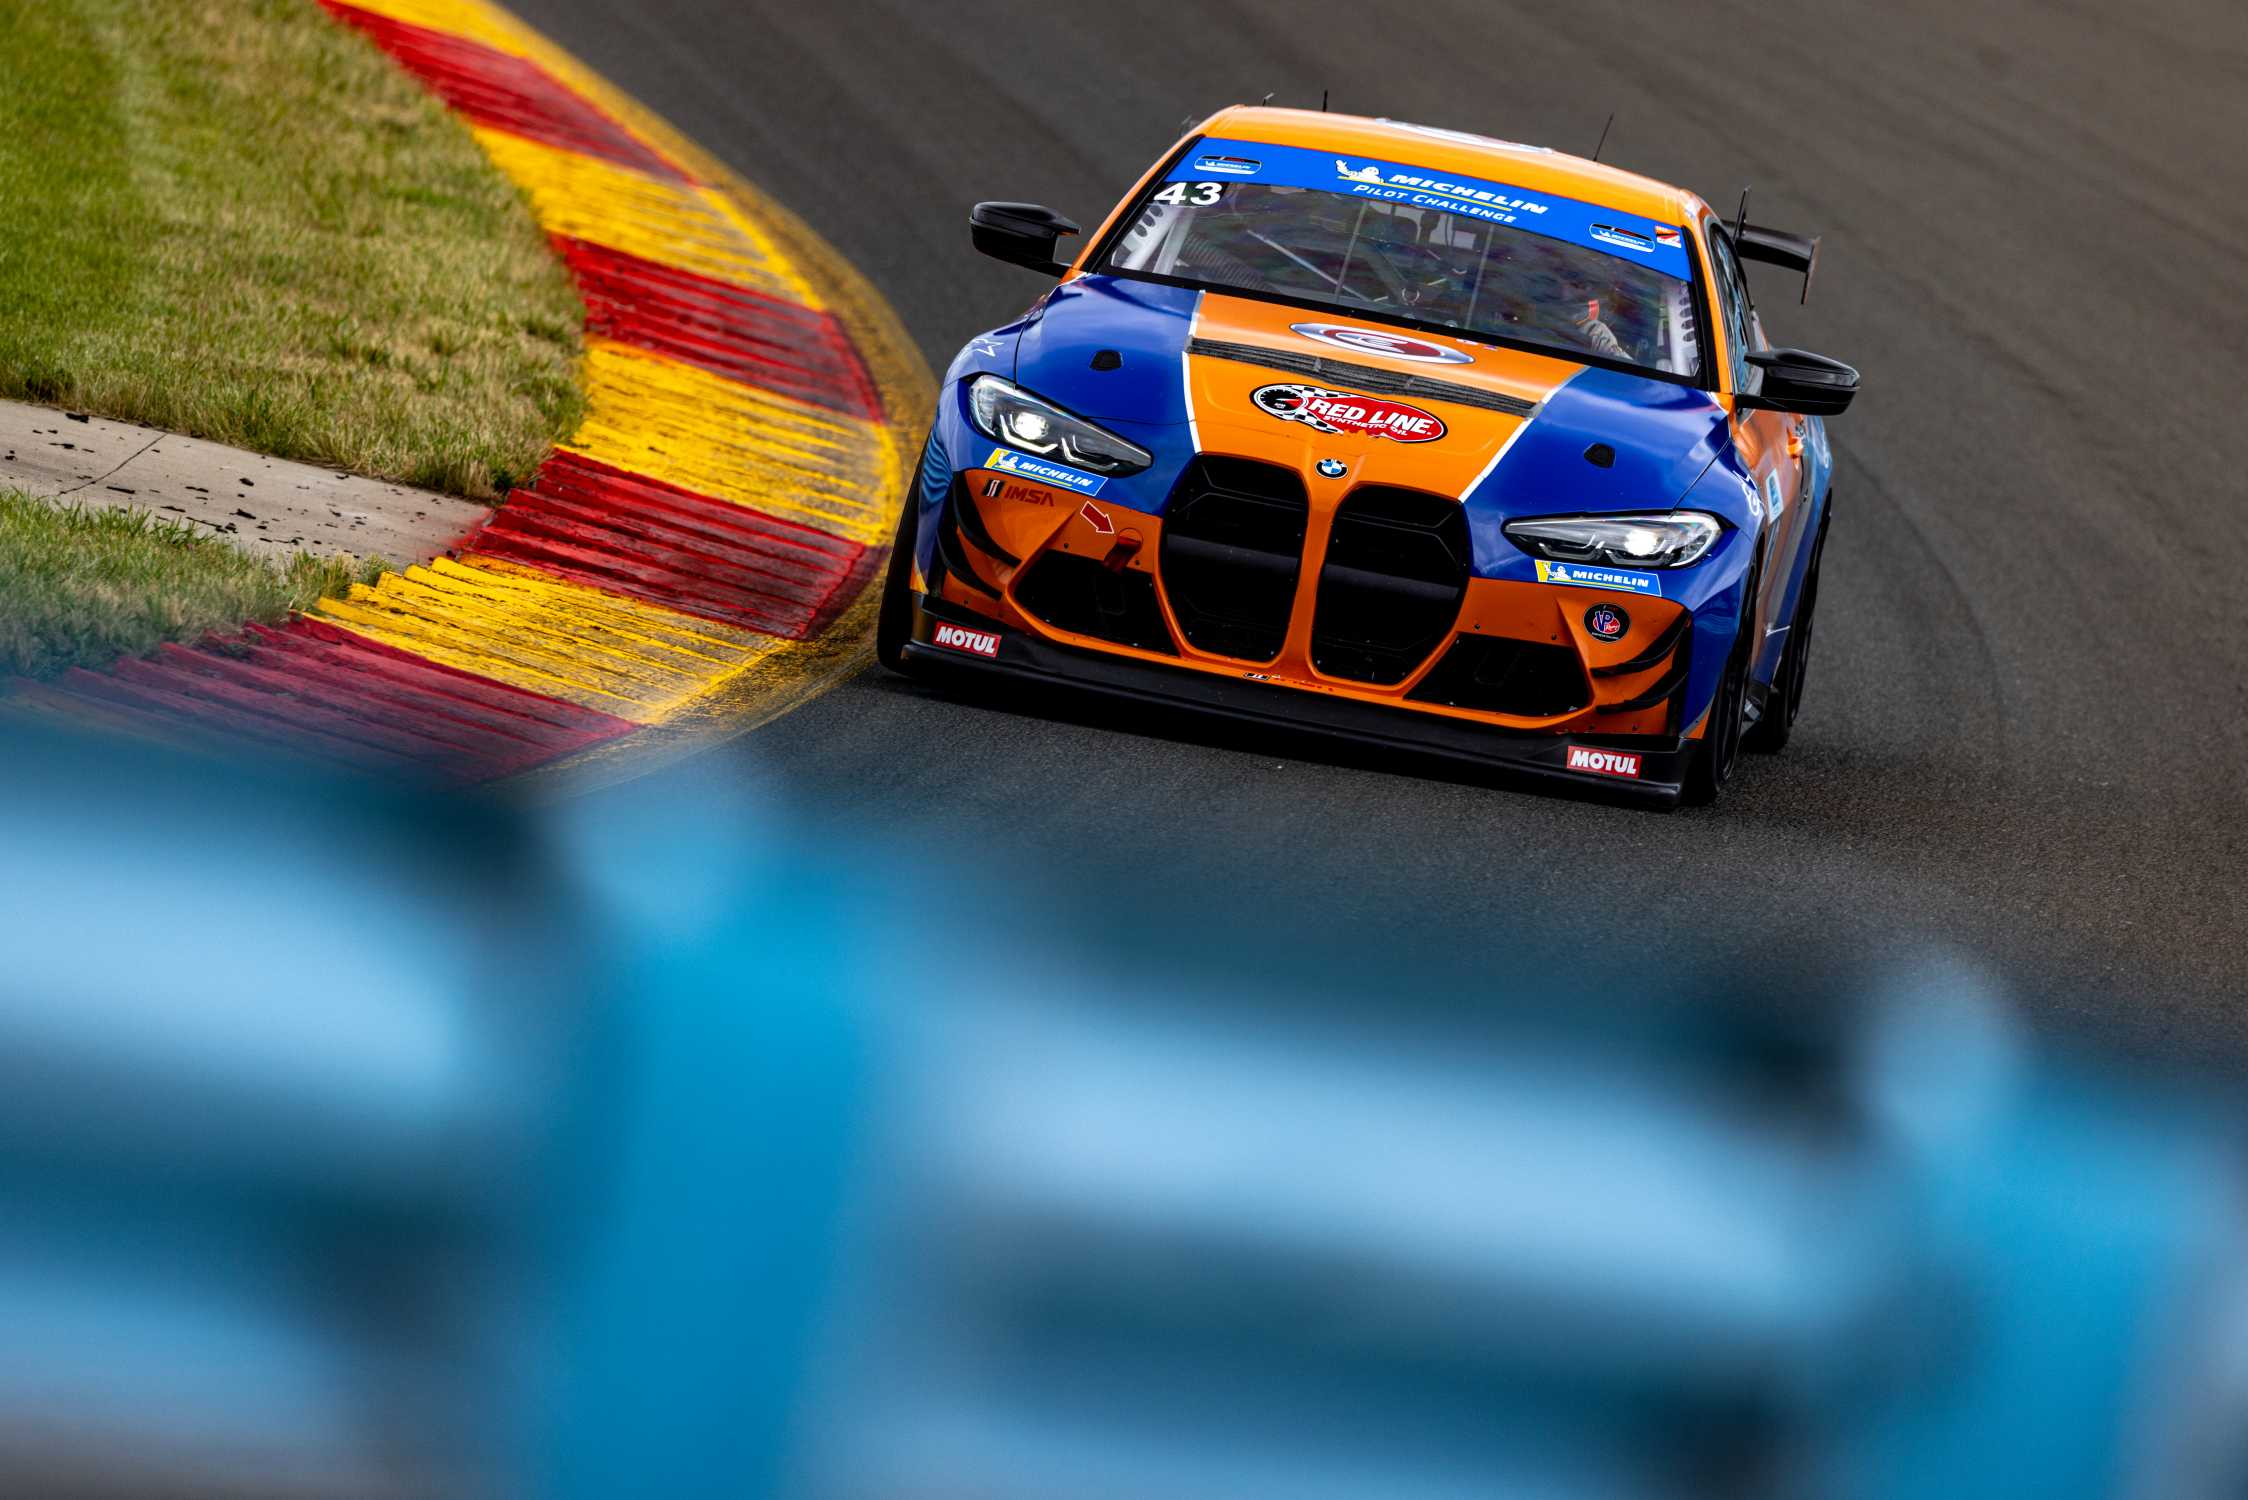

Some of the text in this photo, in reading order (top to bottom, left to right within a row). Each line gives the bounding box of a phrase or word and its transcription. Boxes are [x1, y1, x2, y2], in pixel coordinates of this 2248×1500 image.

[1153, 182, 1222, 206] 43
[1353, 184, 1517, 223] PILOT CHALLENGE
[1389, 174, 1549, 215] MICHELIN
[1308, 399, 1434, 434] RED LINE
[1323, 415, 1408, 436] SYNTHETIC OIL
[1018, 462, 1094, 487] MICHELIN
[1004, 486, 1055, 507] IMSA
[1572, 570, 1649, 588] MICHELIN
[935, 626, 996, 654] MOTUL
[1570, 750, 1637, 775] MOTUL
